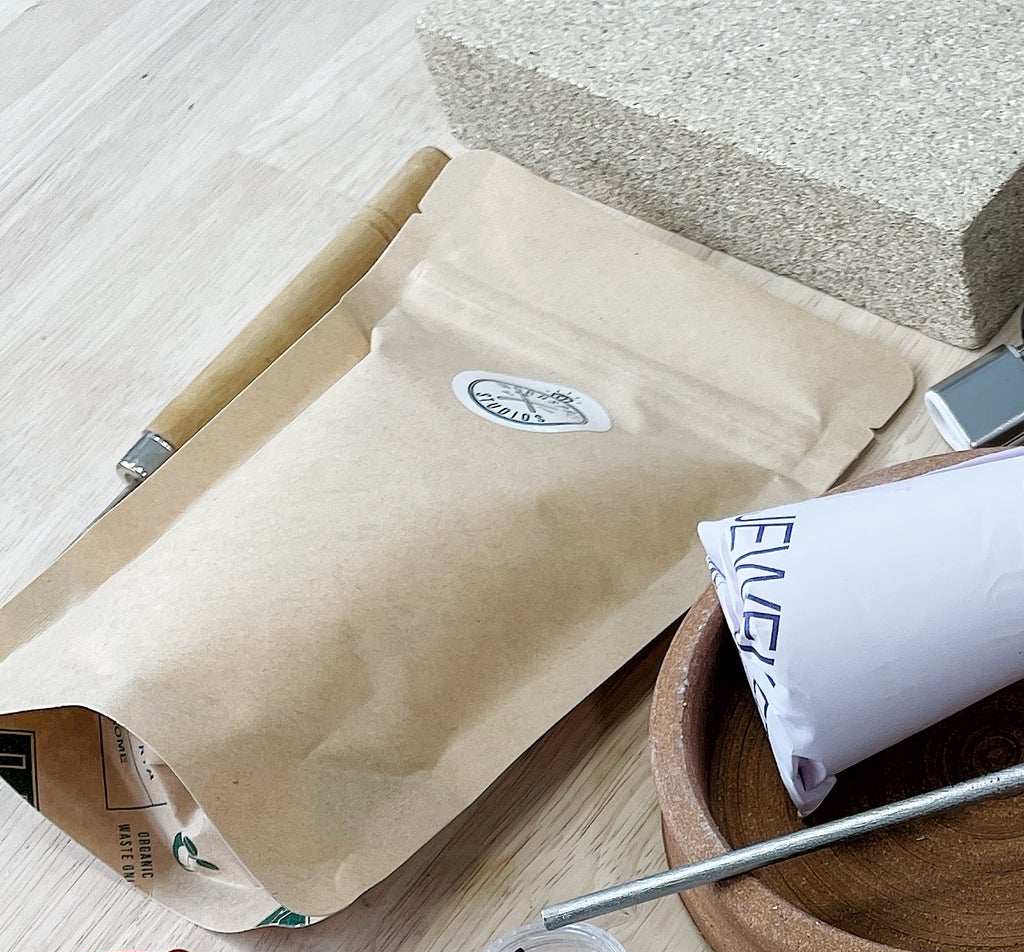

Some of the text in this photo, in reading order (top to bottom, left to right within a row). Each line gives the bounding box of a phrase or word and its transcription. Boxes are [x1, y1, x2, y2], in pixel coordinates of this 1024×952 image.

[475, 391, 546, 423] STUDIOS
[118, 823, 134, 860] WASTE
[138, 831, 154, 879] ORGANIC
